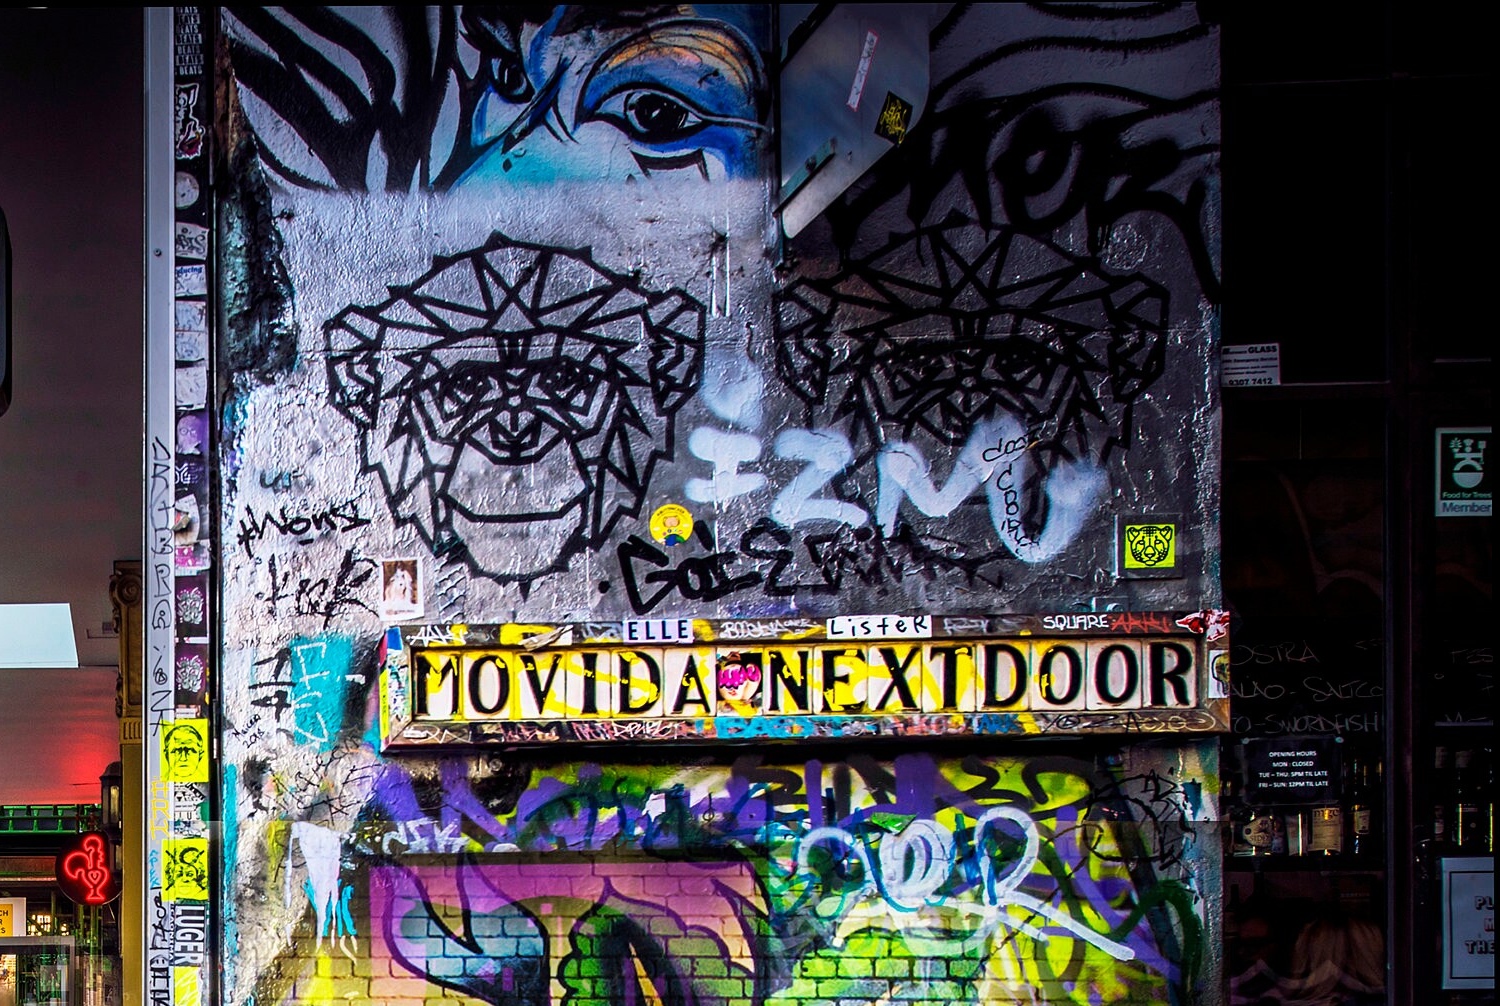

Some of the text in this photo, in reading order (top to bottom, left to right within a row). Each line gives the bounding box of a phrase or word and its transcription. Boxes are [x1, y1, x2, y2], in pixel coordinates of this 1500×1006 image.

[1247, 345, 1277, 354] GLASS
[1442, 501, 1491, 513] Member
[628, 619, 689, 640] ELLE
[1043, 614, 1109, 631] SQUARE
[414, 651, 712, 716] MOVIDA
[1263, 711, 1379, 735] SWORDFISH
[174, 905, 205, 965] LUGER
